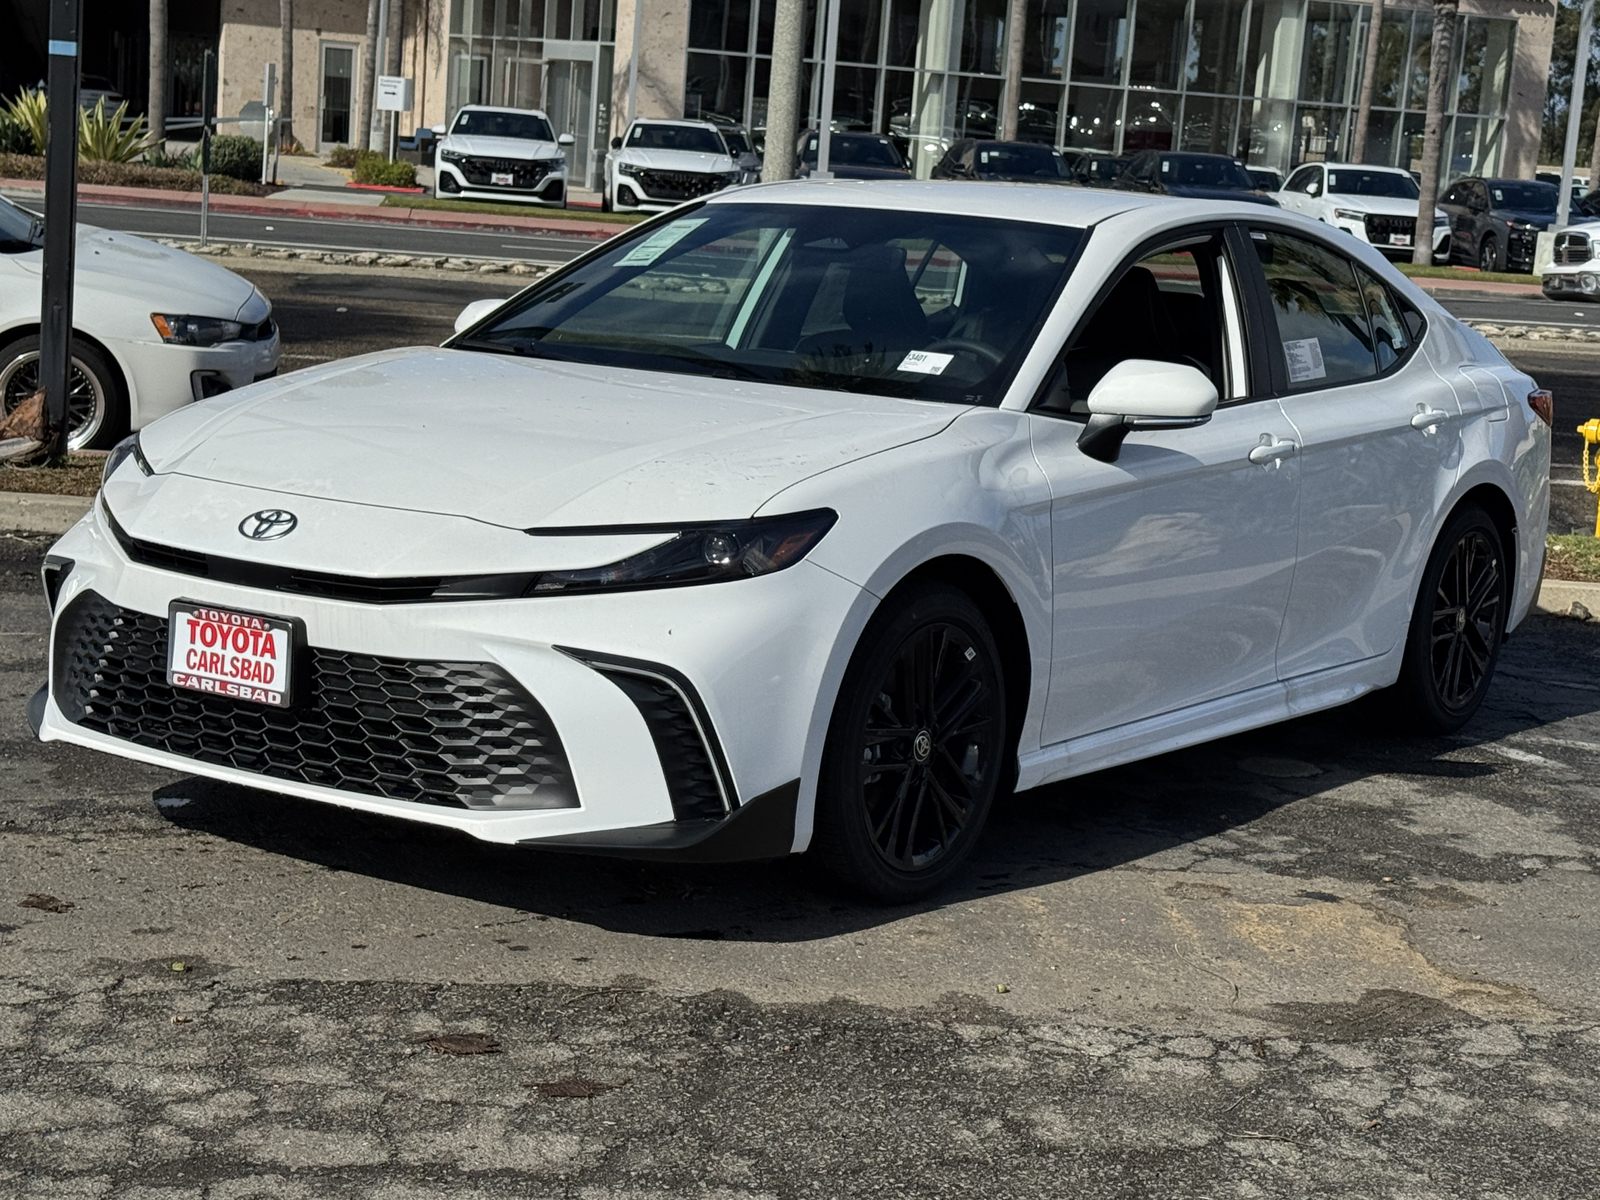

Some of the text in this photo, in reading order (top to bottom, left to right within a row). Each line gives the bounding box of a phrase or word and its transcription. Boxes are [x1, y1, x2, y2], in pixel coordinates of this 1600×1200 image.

[199, 608, 262, 630] TOYOTA
[187, 618, 277, 660] TOYOTA
[186, 648, 275, 685] CARLSBAD
[172, 673, 282, 705] CARLSBAD
